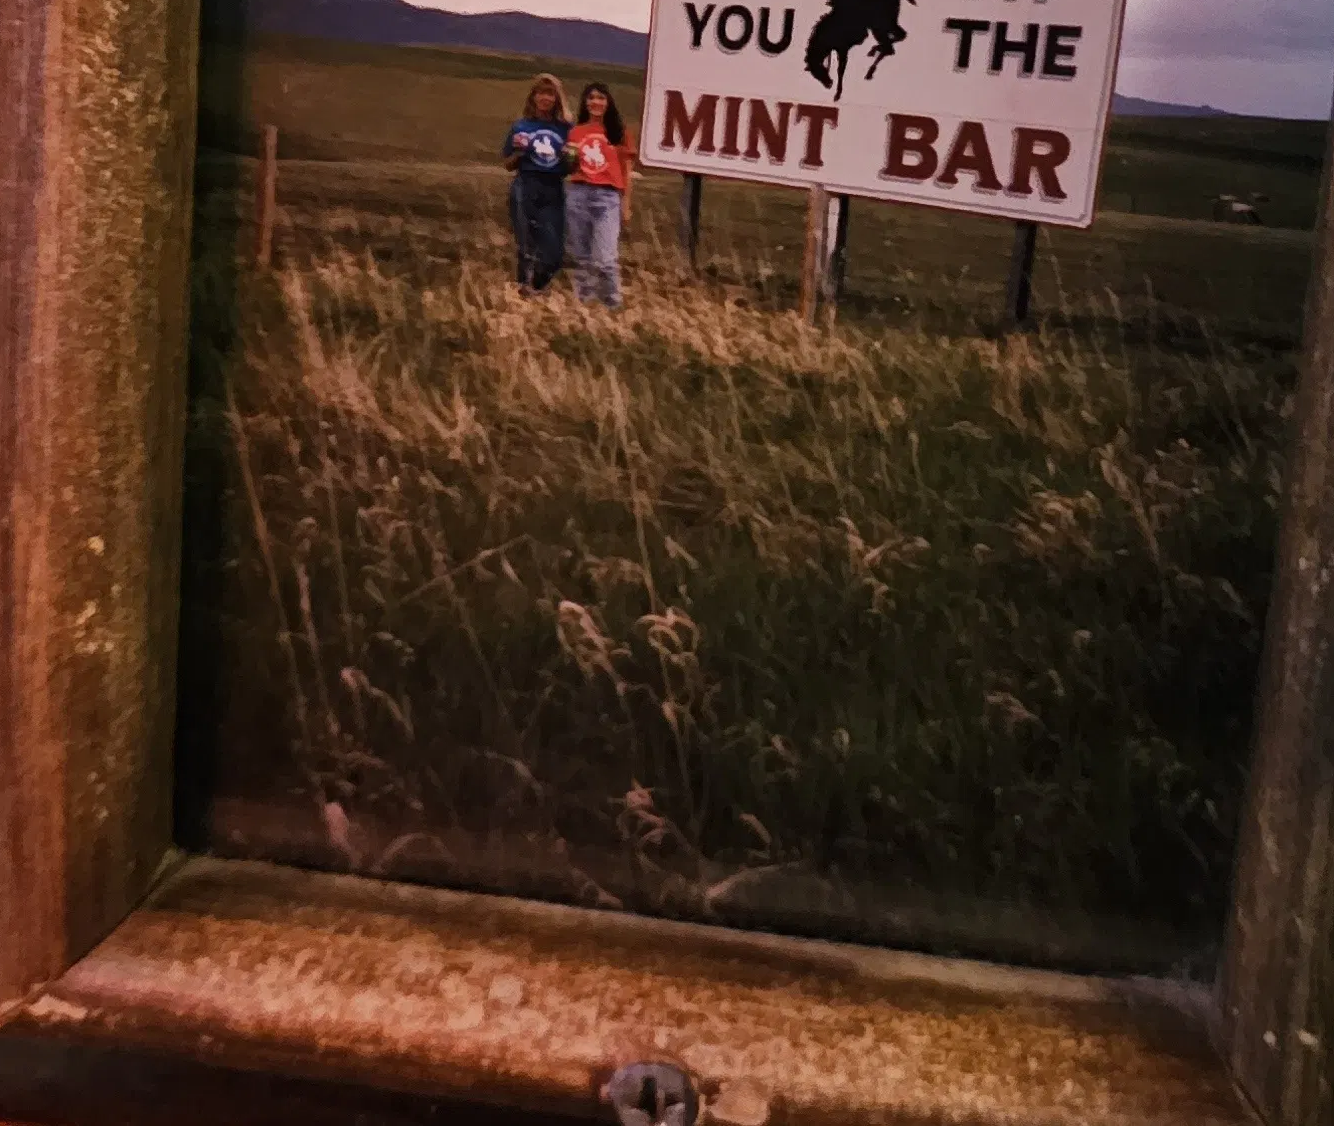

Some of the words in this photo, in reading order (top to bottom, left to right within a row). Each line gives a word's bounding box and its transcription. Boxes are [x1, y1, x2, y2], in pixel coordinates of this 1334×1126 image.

[685, 3, 796, 55] YOU
[943, 17, 1083, 79] THE
[660, 90, 839, 168] MINT
[880, 113, 1072, 200] BAR
